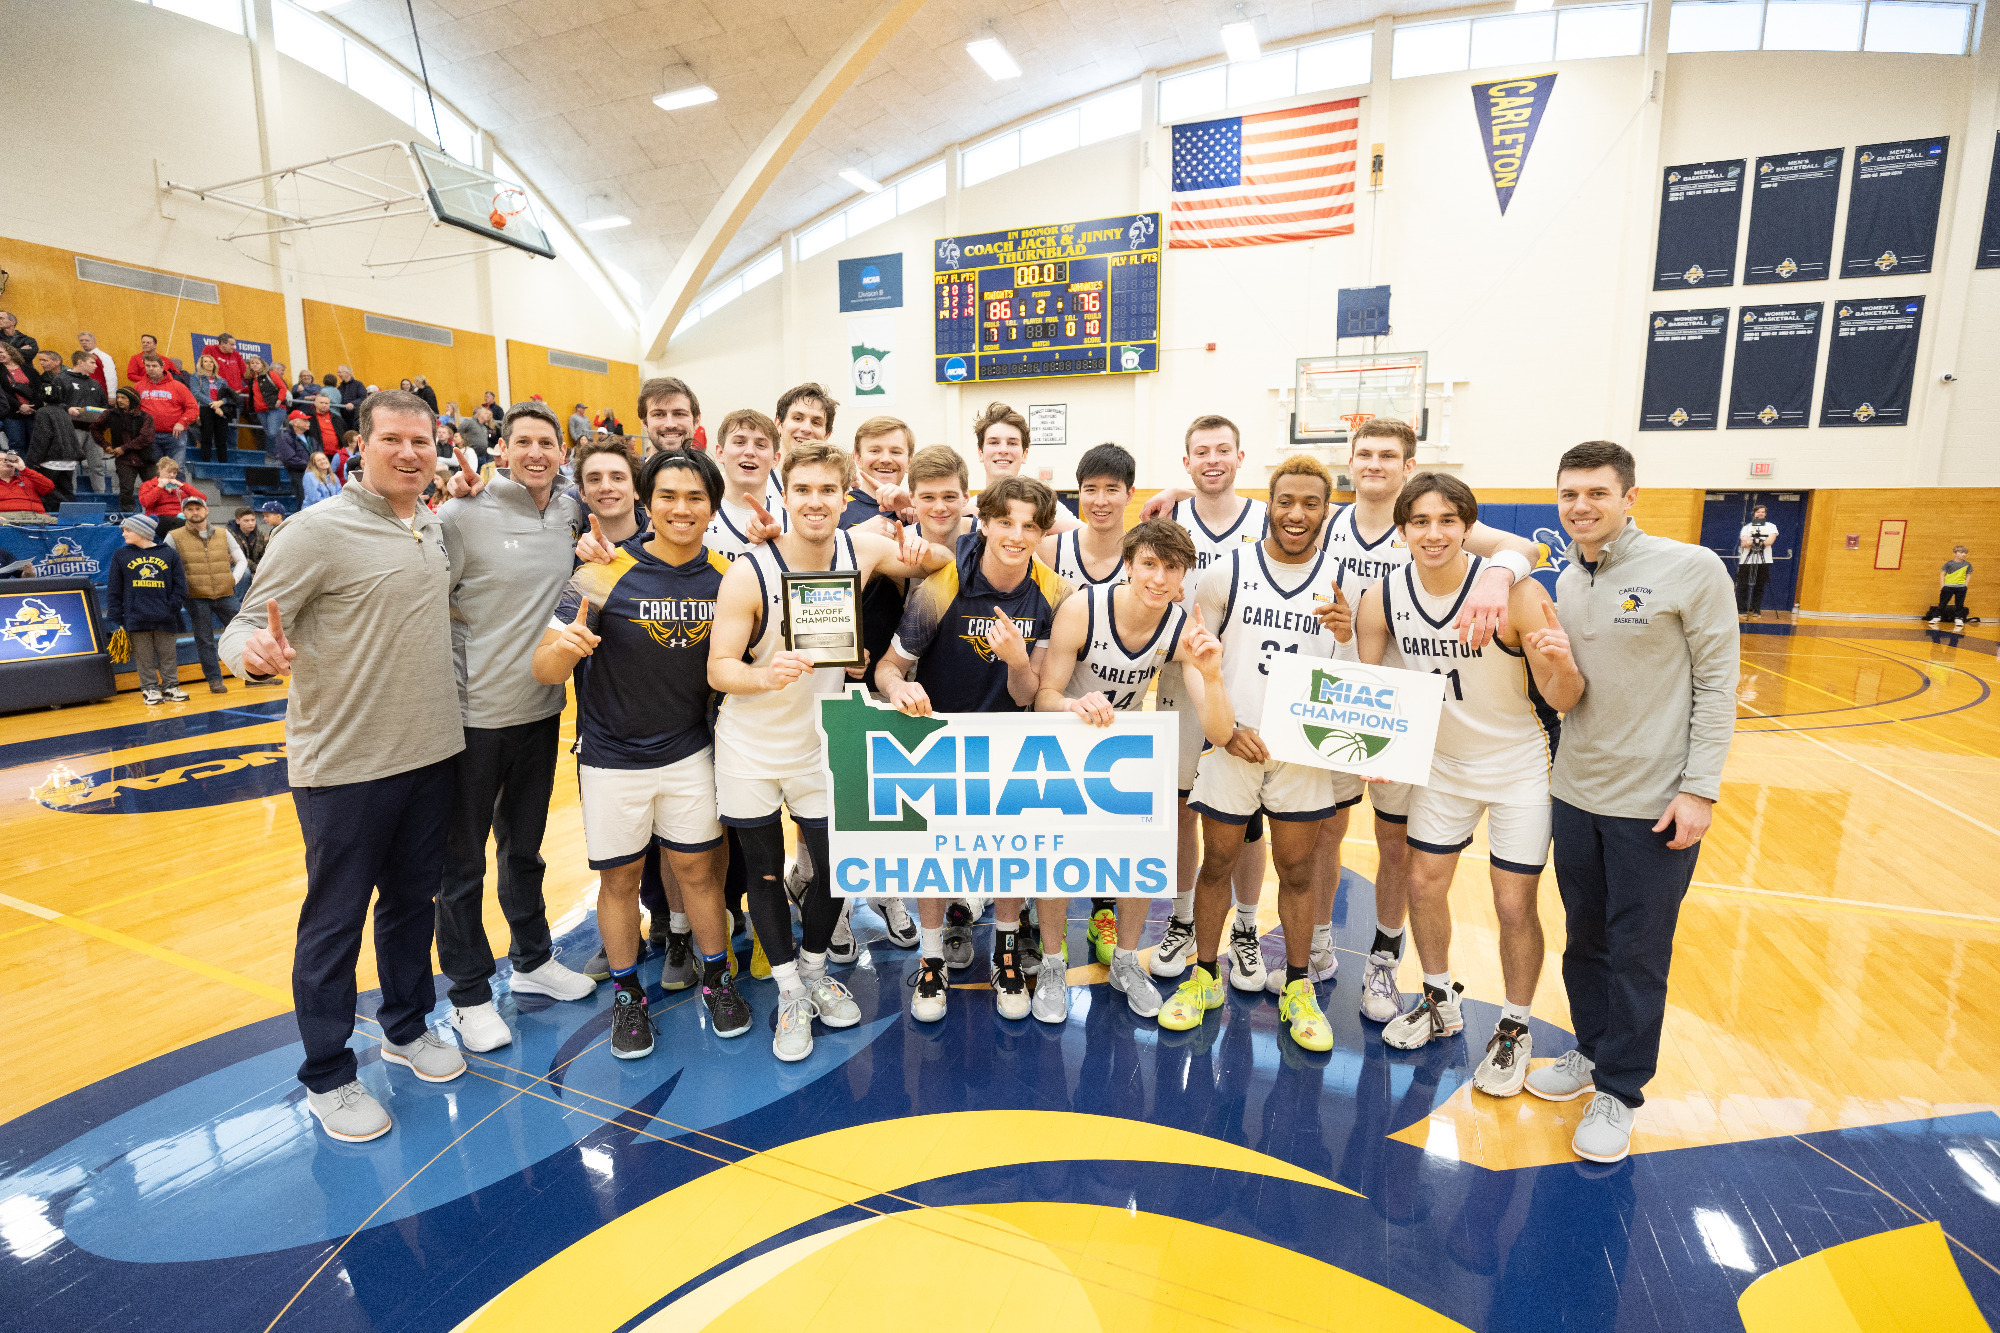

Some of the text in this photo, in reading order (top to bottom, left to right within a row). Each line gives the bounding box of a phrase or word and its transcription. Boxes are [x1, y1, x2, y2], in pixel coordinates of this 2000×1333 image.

[1488, 80, 1538, 188] CARLETON
[1877, 152, 1923, 161] BASKETBALL
[1776, 163, 1820, 172] BASKETBALL
[1683, 173, 1724, 181] BASKETBALL
[1007, 224, 1076, 240] IN HONOR OF
[964, 228, 1124, 257] COACH JACK & JINNY
[996, 244, 1087, 264] THURNBLAD
[1141, 253, 1158, 263] PTS
[961, 273, 975, 282] PTS
[942, 285, 950, 297] 2
[966, 283, 974, 294] 6
[942, 294, 974, 308] 3 2 2
[989, 292, 1101, 320] 86 2 76
[951, 308, 959, 319] 2
[963, 306, 975, 317] 19
[1023, 317, 1043, 325] PLAYER
[1084, 312, 1102, 320] FOULS
[989, 327, 998, 342] 7
[1065, 321, 1077, 337] 0
[1085, 319, 1100, 335] 10
[1084, 336, 1102, 344] SCORE
[1755, 462, 1770, 474] EXIT
[127, 556, 169, 571] CARLETON
[805, 590, 842, 602] MIAC
[1618, 586, 1653, 596] CARLETON
[802, 607, 844, 616] PLAYOFF
[795, 615, 851, 624] CHAMPIONS
[1243, 605, 1321, 636] CARLETON
[1614, 617, 1649, 625] BASKETBALL
[1103, 689, 1137, 710] 14
[1319, 678, 1394, 710] MIAC
[1290, 702, 1409, 733] CHAMPIONS
[872, 734, 1154, 816] MIAC
[935, 834, 1065, 851] PLAYOFF
[835, 857, 1168, 893] CHAMPIONS
